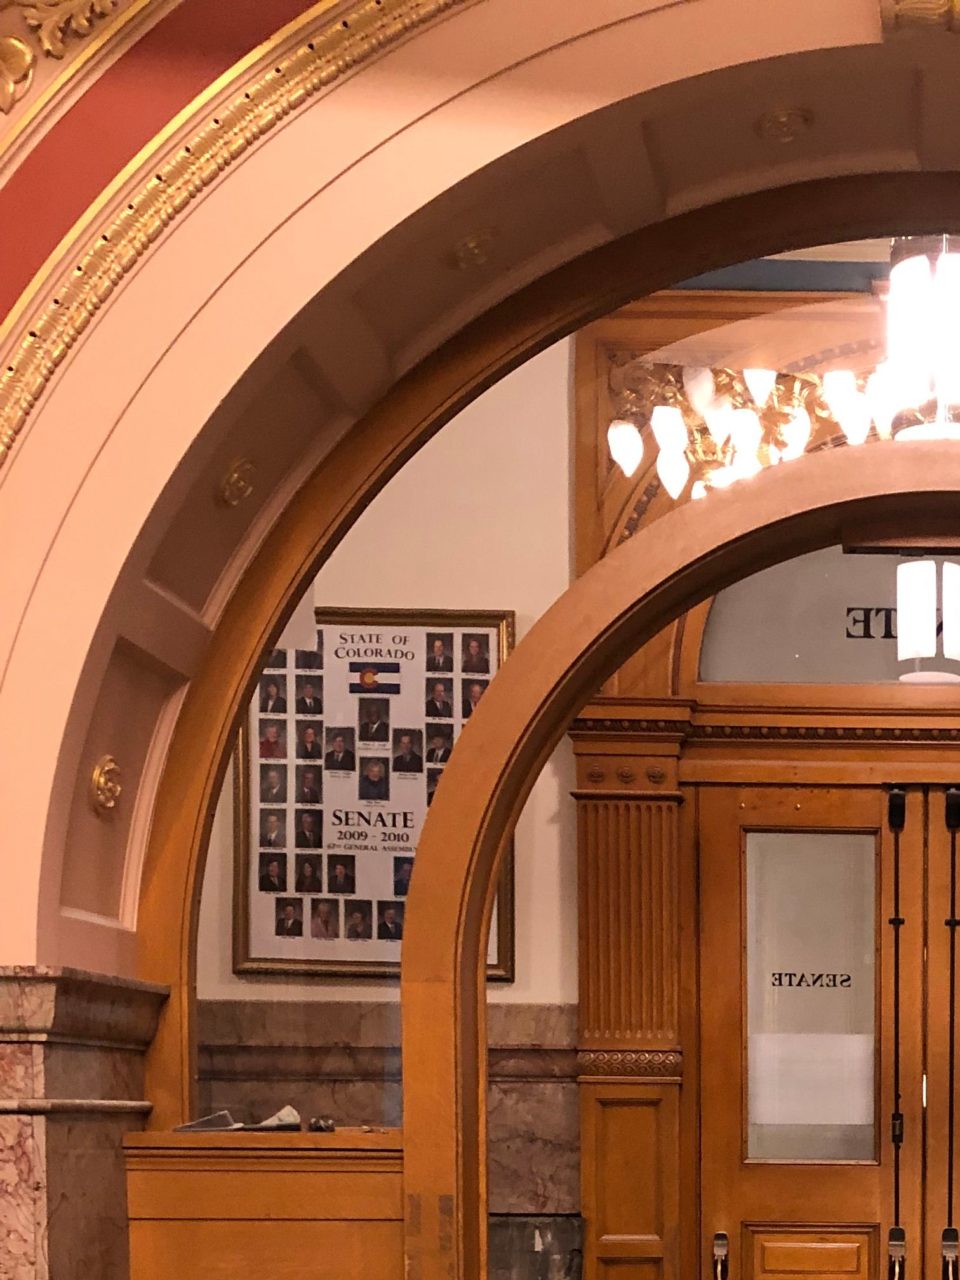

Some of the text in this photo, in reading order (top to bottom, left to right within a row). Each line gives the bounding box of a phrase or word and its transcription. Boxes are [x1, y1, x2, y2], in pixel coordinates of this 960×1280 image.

[339, 633, 410, 646] STATE OF
[334, 646, 415, 661] COLORADO
[331, 808, 415, 829] SENATE
[337, 830, 368, 841] 2009
[381, 831, 410, 843] 2010
[343, 843, 379, 852] GENERAL
